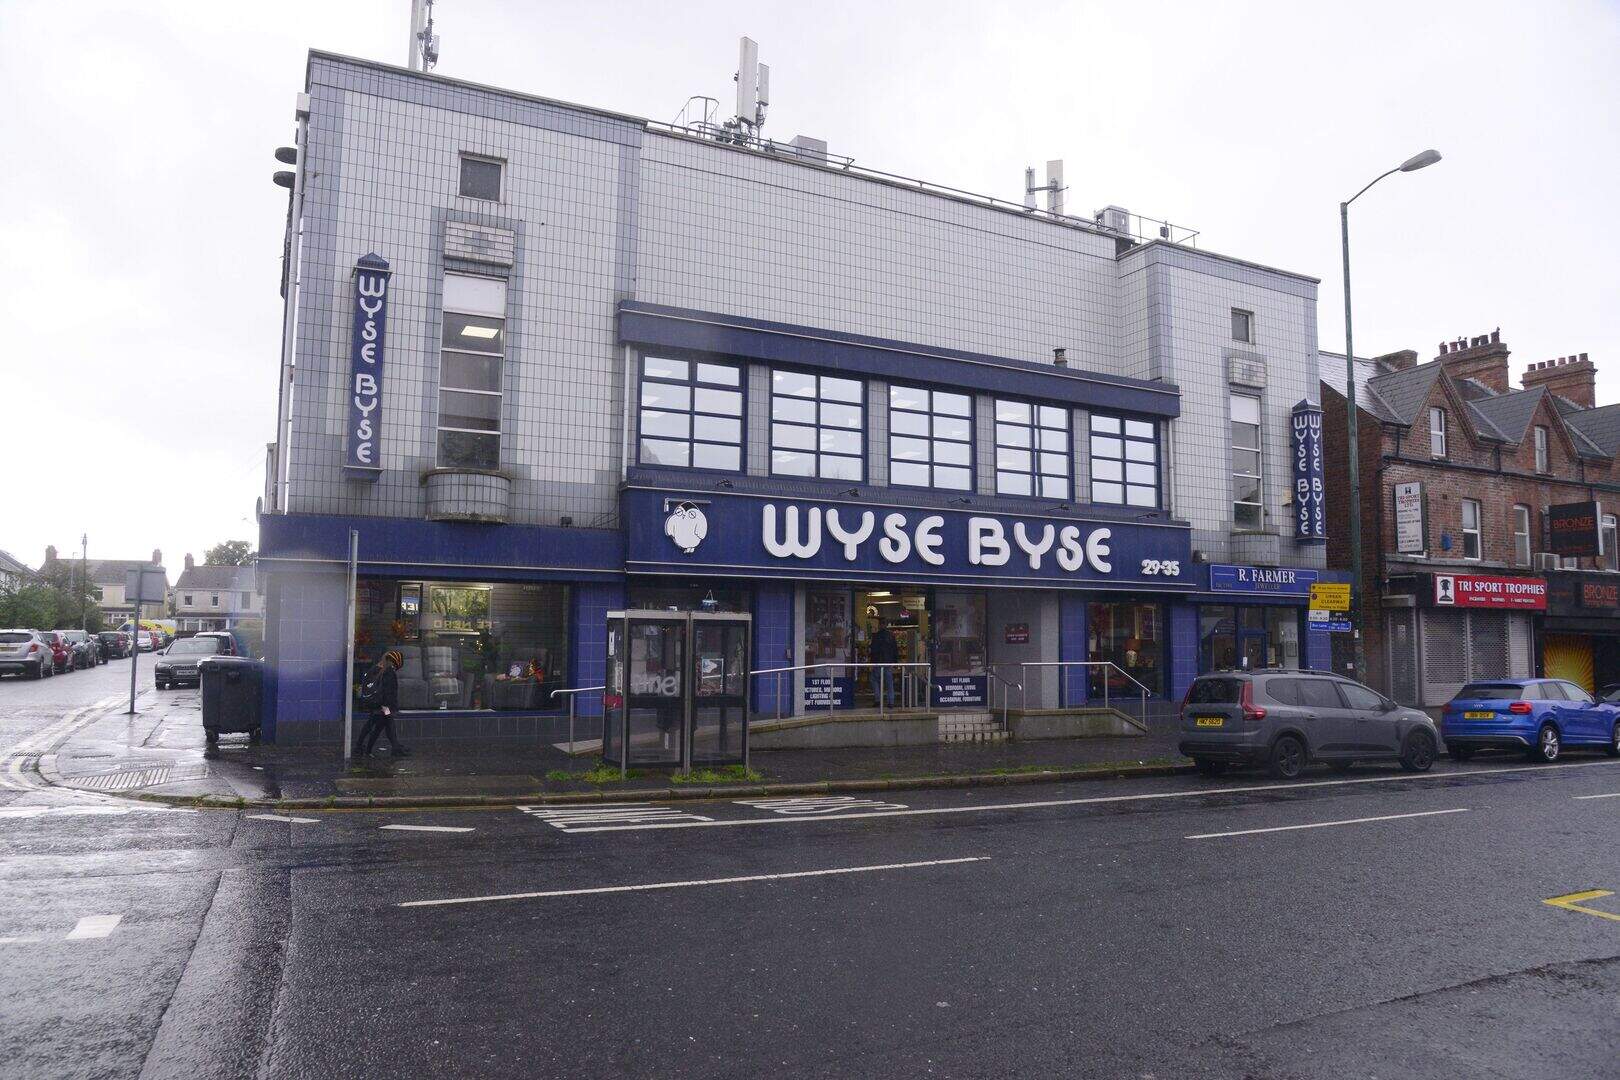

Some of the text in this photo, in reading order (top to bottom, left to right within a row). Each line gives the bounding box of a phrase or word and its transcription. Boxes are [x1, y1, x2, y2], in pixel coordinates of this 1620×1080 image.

[353, 275, 386, 464] WYSE BYSE
[1294, 414, 1310, 535] WYSE BYSE
[1309, 414, 1323, 535] WYSE BYSE
[1553, 516, 1594, 530] BRONZE
[762, 503, 1112, 573] WYSE BYSE
[1141, 559, 1180, 576] 29-35
[1238, 568, 1296, 584] R. FARMER
[1458, 580, 1472, 592] TRI
[1474, 581, 1503, 593] SPORT
[1504, 582, 1545, 595] TROPHIES
[1583, 584, 1617, 600] BRONZE
